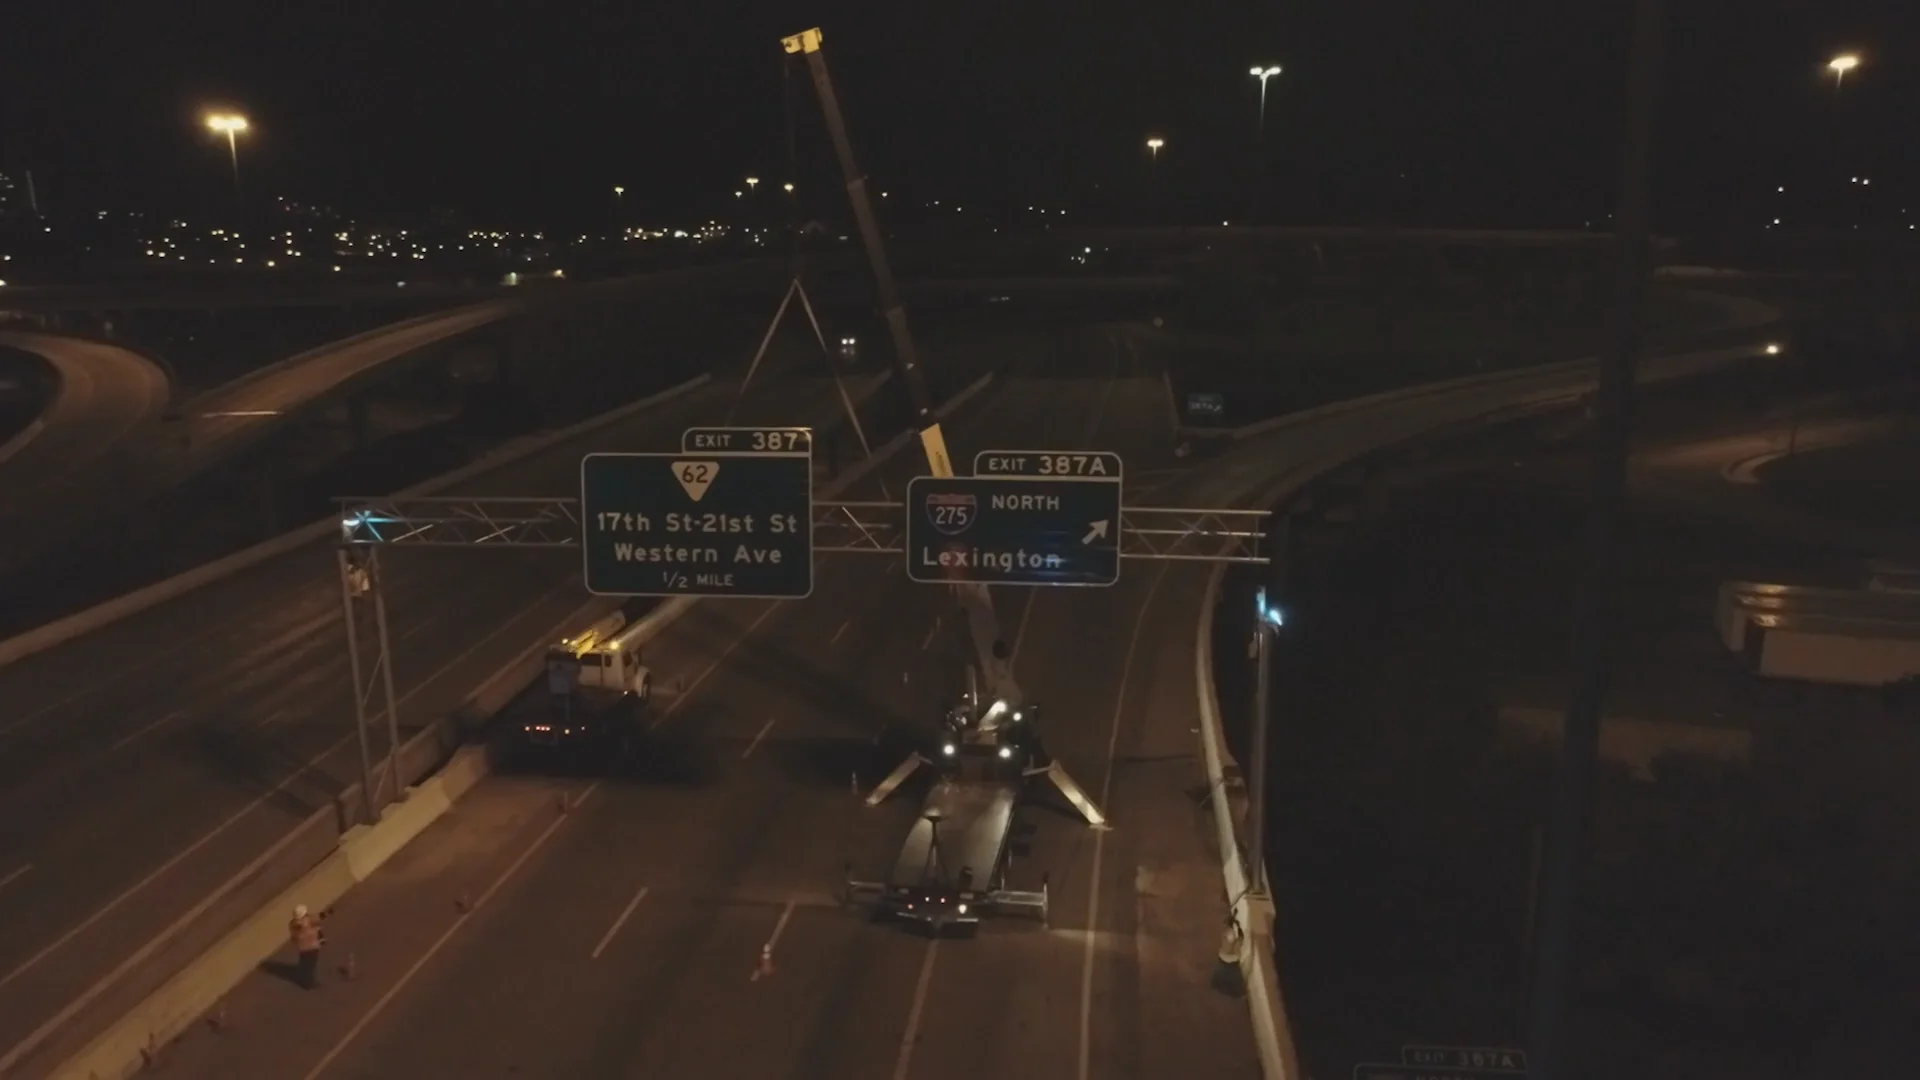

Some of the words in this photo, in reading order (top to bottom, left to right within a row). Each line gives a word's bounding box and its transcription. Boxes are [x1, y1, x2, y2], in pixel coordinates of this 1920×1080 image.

[694, 434, 732, 447] EXIT
[752, 432, 798, 450] 387
[681, 464, 709, 483] 62
[988, 457, 1026, 471] EXIT
[1038, 456, 1107, 475] 387A
[991, 495, 1060, 510] NORTH
[597, 512, 650, 531] 17th
[769, 514, 798, 533] St
[935, 506, 967, 525] 275
[614, 542, 718, 562] Western
[733, 545, 782, 564] Ave
[923, 546, 1061, 573] Lexington
[696, 574, 734, 586] MILE
